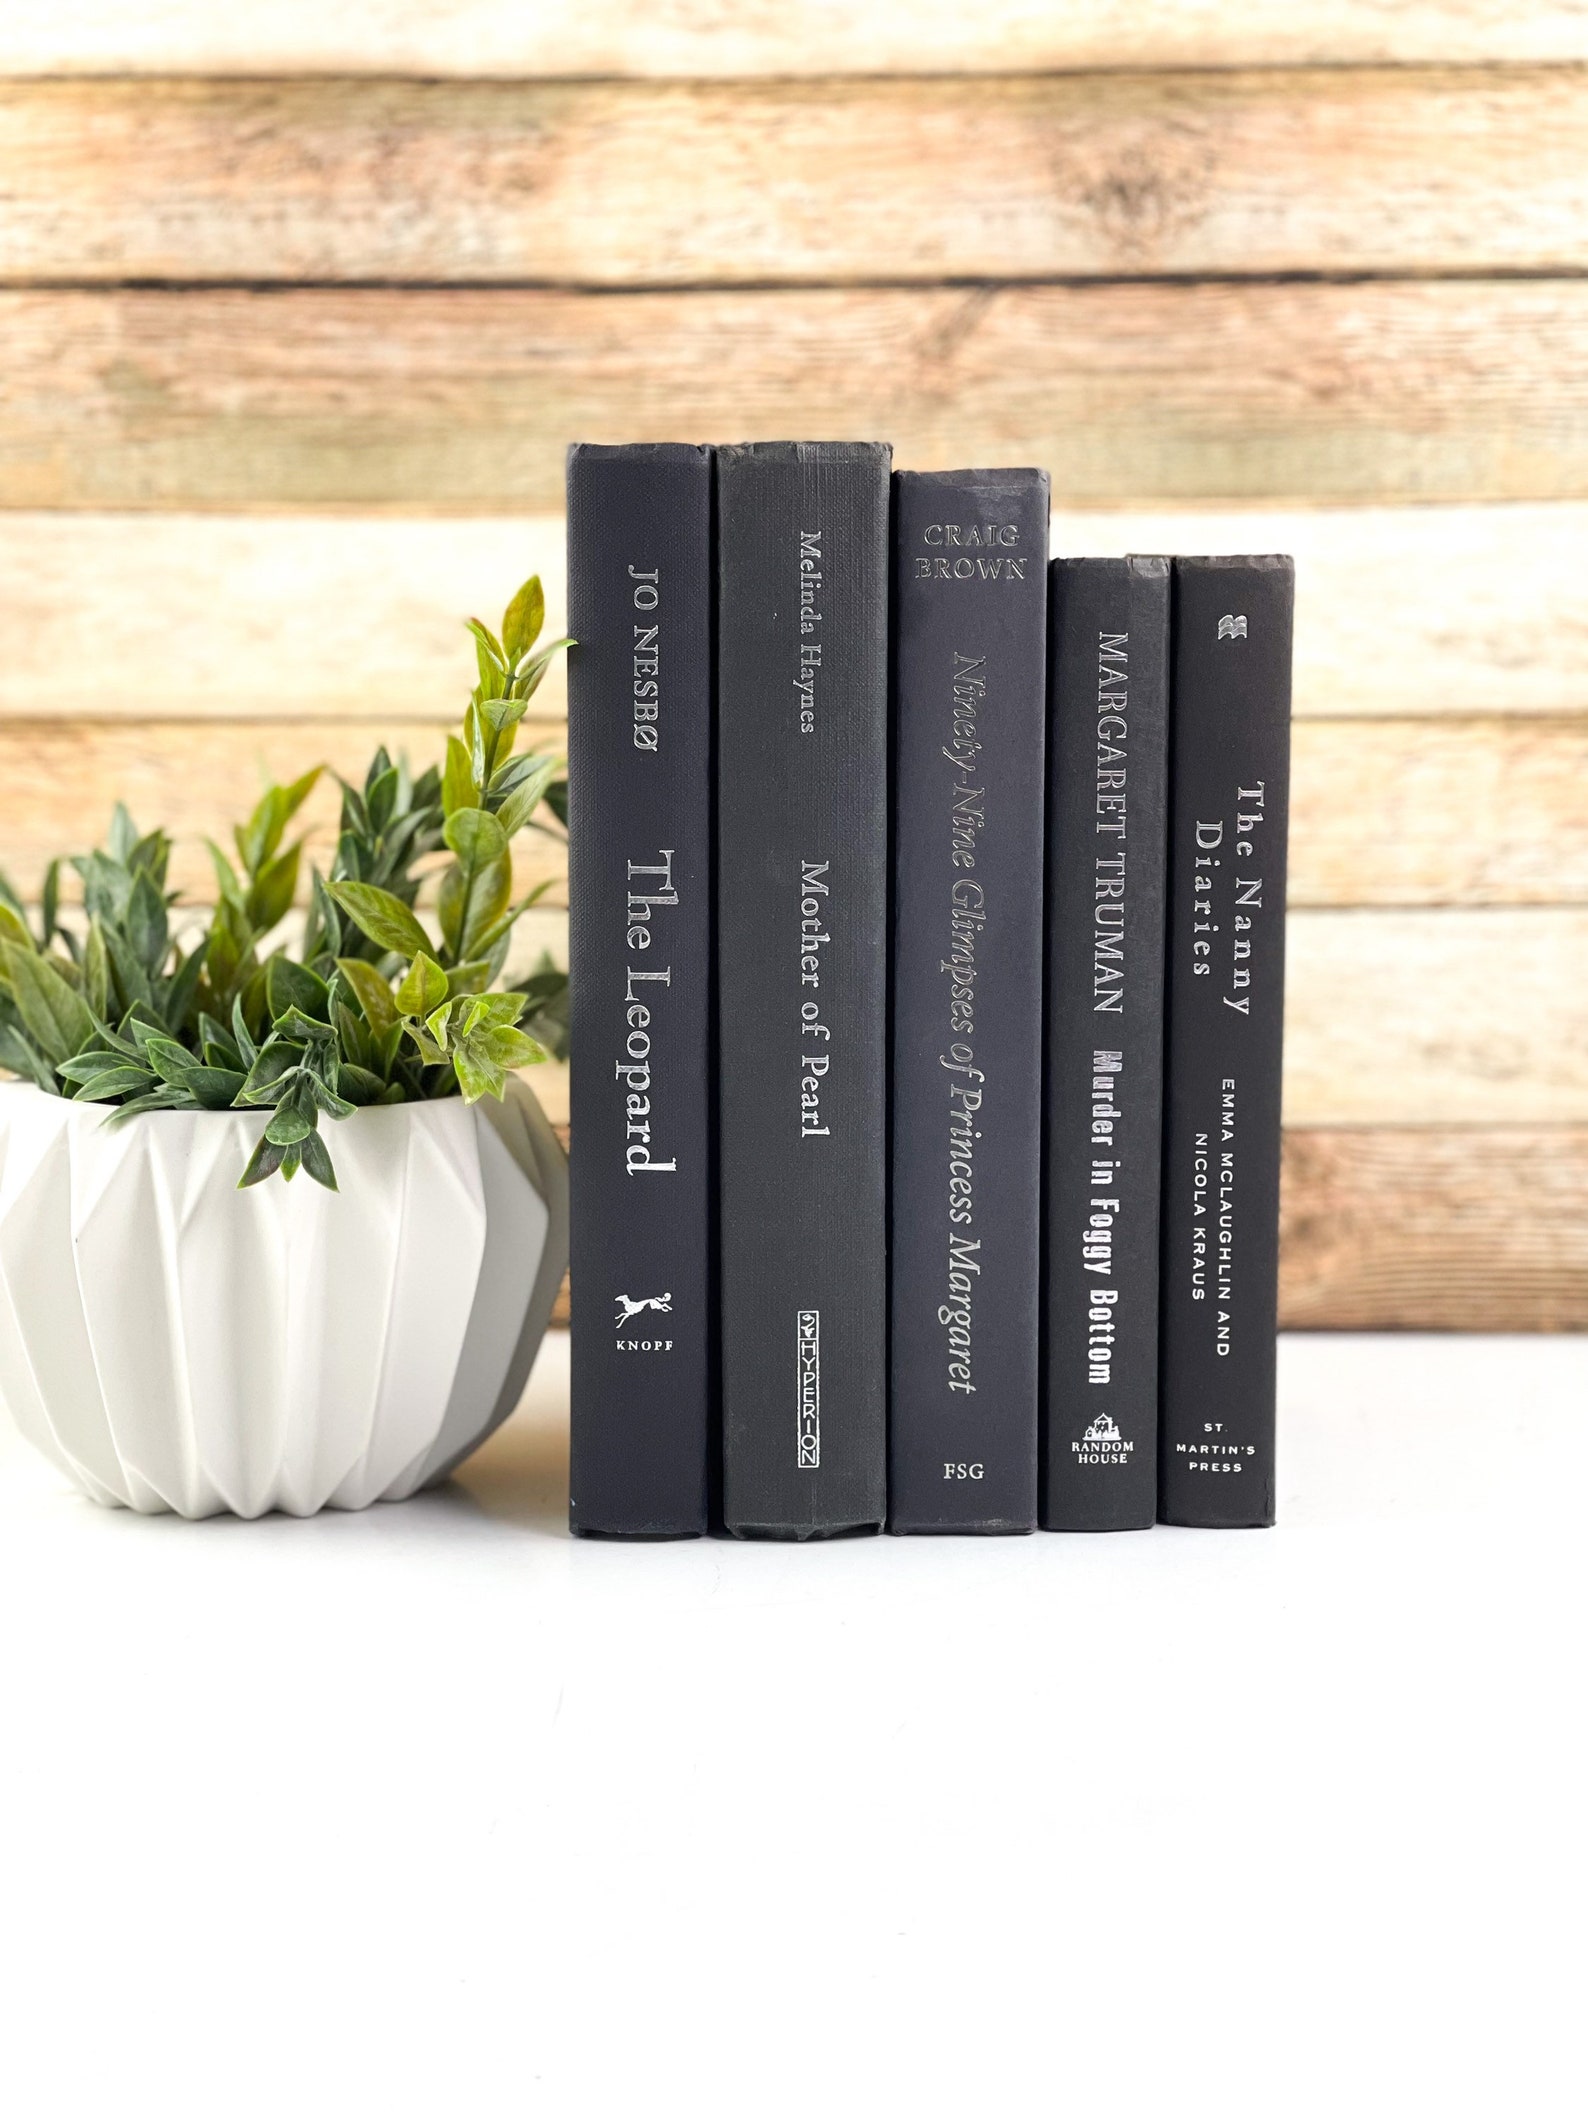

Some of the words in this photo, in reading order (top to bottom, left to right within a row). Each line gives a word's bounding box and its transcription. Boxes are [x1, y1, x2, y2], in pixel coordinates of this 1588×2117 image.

[914, 556, 1028, 580] BROWN
[923, 524, 1020, 547] CRAIG
[628, 564, 659, 611] JO
[800, 530, 823, 634] Melinda
[633, 624, 659, 752] NESBØ
[793, 644, 822, 734] Haynes
[942, 652, 986, 869] Ninety-Nine
[1096, 631, 1129, 840] MARGARET
[1236, 780, 1264, 857] The
[626, 849, 679, 950] The
[801, 861, 831, 988] Mother
[1094, 852, 1126, 1014] TRUMAN
[1194, 821, 1223, 976] Diaries
[941, 879, 985, 1034] Glimpses
[1223, 877, 1263, 1015] Nanny
[801, 1001, 830, 1041] of
[940, 1041, 985, 1083] of
[615, 965, 677, 1176] Leopard
[802, 1055, 831, 1138] Pearl
[1092, 1050, 1123, 1146] Murder
[1222, 1078, 1235, 1142] EMMA
[949, 1083, 983, 1225] Princess
[1091, 1160, 1121, 1185] in
[1194, 1133, 1208, 1216] NICOLA
[1083, 1198, 1120, 1275] Foggy
[1192, 1227, 1206, 1300] KRAUS
[1217, 1152, 1234, 1300] MCLAUGHLIN
[616, 1340, 673, 1351] KNOPF
[938, 1232, 981, 1395] Margaret
[1088, 1289, 1118, 1384] Bottom
[1217, 1311, 1230, 1357] AND
[801, 1342, 816, 1464] HYPERION
[943, 1463, 985, 1480] FSG
[1072, 1440, 1134, 1452] RANDOM
[1078, 1452, 1128, 1464] HOUSE
[1176, 1444, 1256, 1455] MARTIN'S
[1189, 1462, 1243, 1473] PRESS
